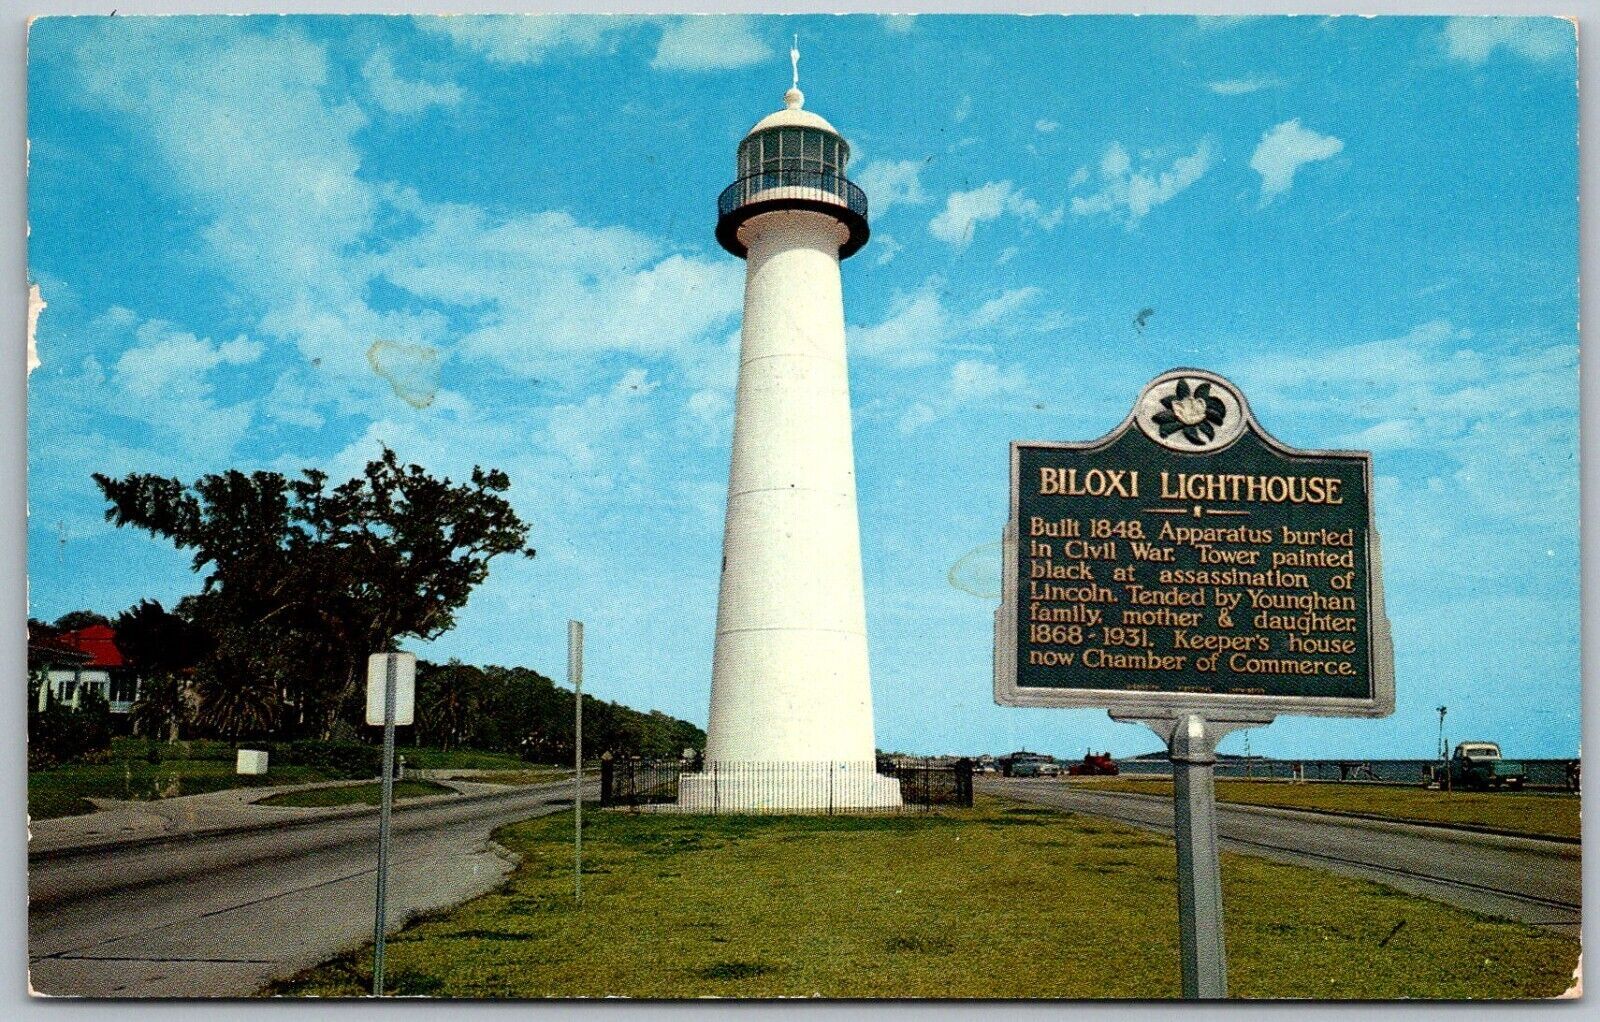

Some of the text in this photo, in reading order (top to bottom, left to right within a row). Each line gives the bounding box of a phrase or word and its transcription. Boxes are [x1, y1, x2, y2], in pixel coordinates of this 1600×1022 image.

[1039, 467, 1343, 505] BILOXI LIGHTHOUSE
[1030, 517, 1080, 537] Built
[1159, 521, 1272, 545] Apparatus
[1283, 526, 1353, 546] buried
[1031, 541, 1354, 569] in Civil War. Tower painted
[1030, 560, 1355, 589] black at assassination of
[1030, 582, 1356, 616] Lincoln. Tended by Younghan
[1123, 607, 1203, 626] mother
[1218, 608, 1234, 627] &
[1030, 625, 1083, 644] 1868
[1104, 627, 1154, 647] 1931.
[1174, 630, 1269, 654] Keeper's
[1289, 634, 1356, 653] house
[1030, 648, 1356, 674] now Chamber of Commerce.
